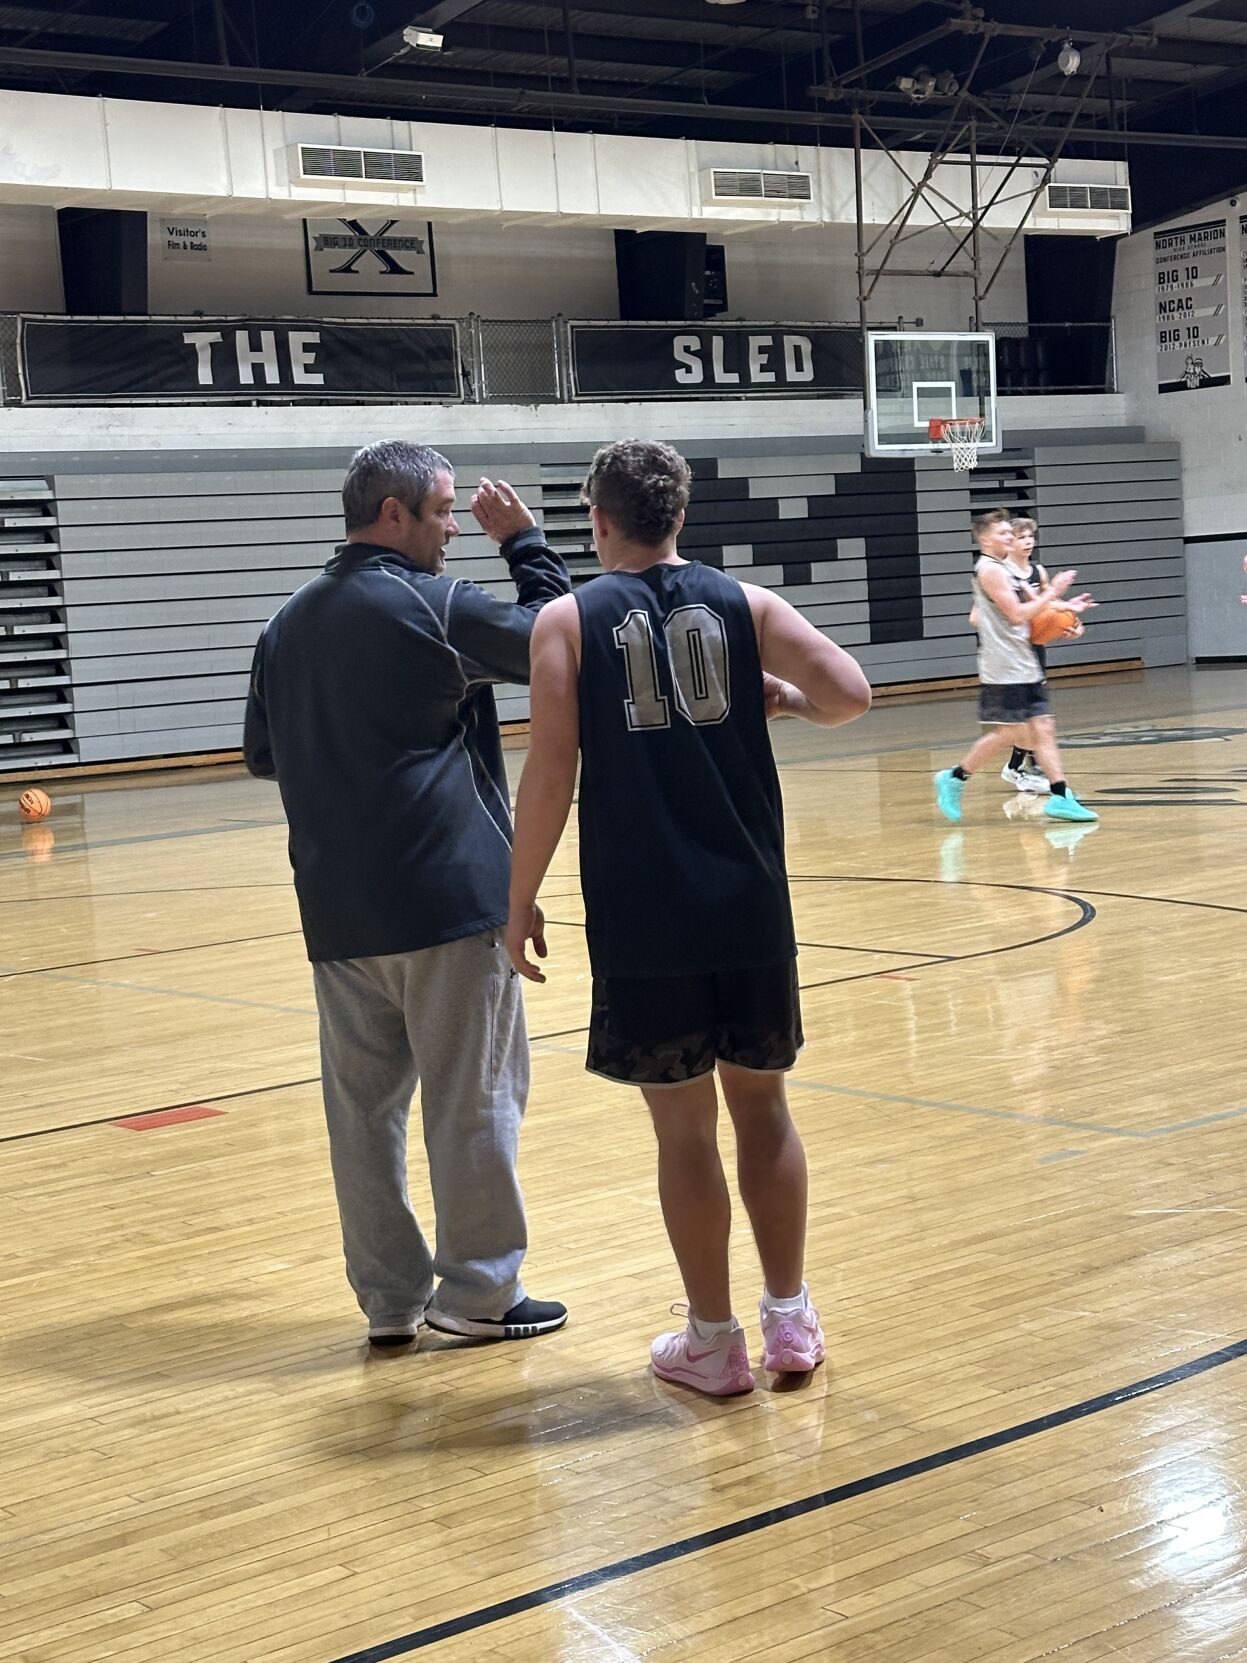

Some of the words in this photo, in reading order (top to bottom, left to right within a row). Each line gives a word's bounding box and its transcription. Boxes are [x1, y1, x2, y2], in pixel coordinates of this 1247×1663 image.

[167, 226, 207, 238] Visitor's
[1155, 235, 1186, 251] NORTH
[1189, 228, 1226, 245] MARION
[323, 236, 338, 247] BIG
[343, 237, 354, 248] 10
[1156, 252, 1190, 264] CONFERENCE
[1192, 246, 1226, 258] AFFILIATION
[1158, 269, 1179, 285] BIG
[1185, 266, 1198, 280] 10
[1158, 297, 1193, 314] NCAC
[1160, 329, 1180, 343] BIG
[1186, 326, 1199, 339] 10
[182, 330, 325, 385] THE
[672, 335, 815, 384] SLED
[612, 603, 731, 732] 10
